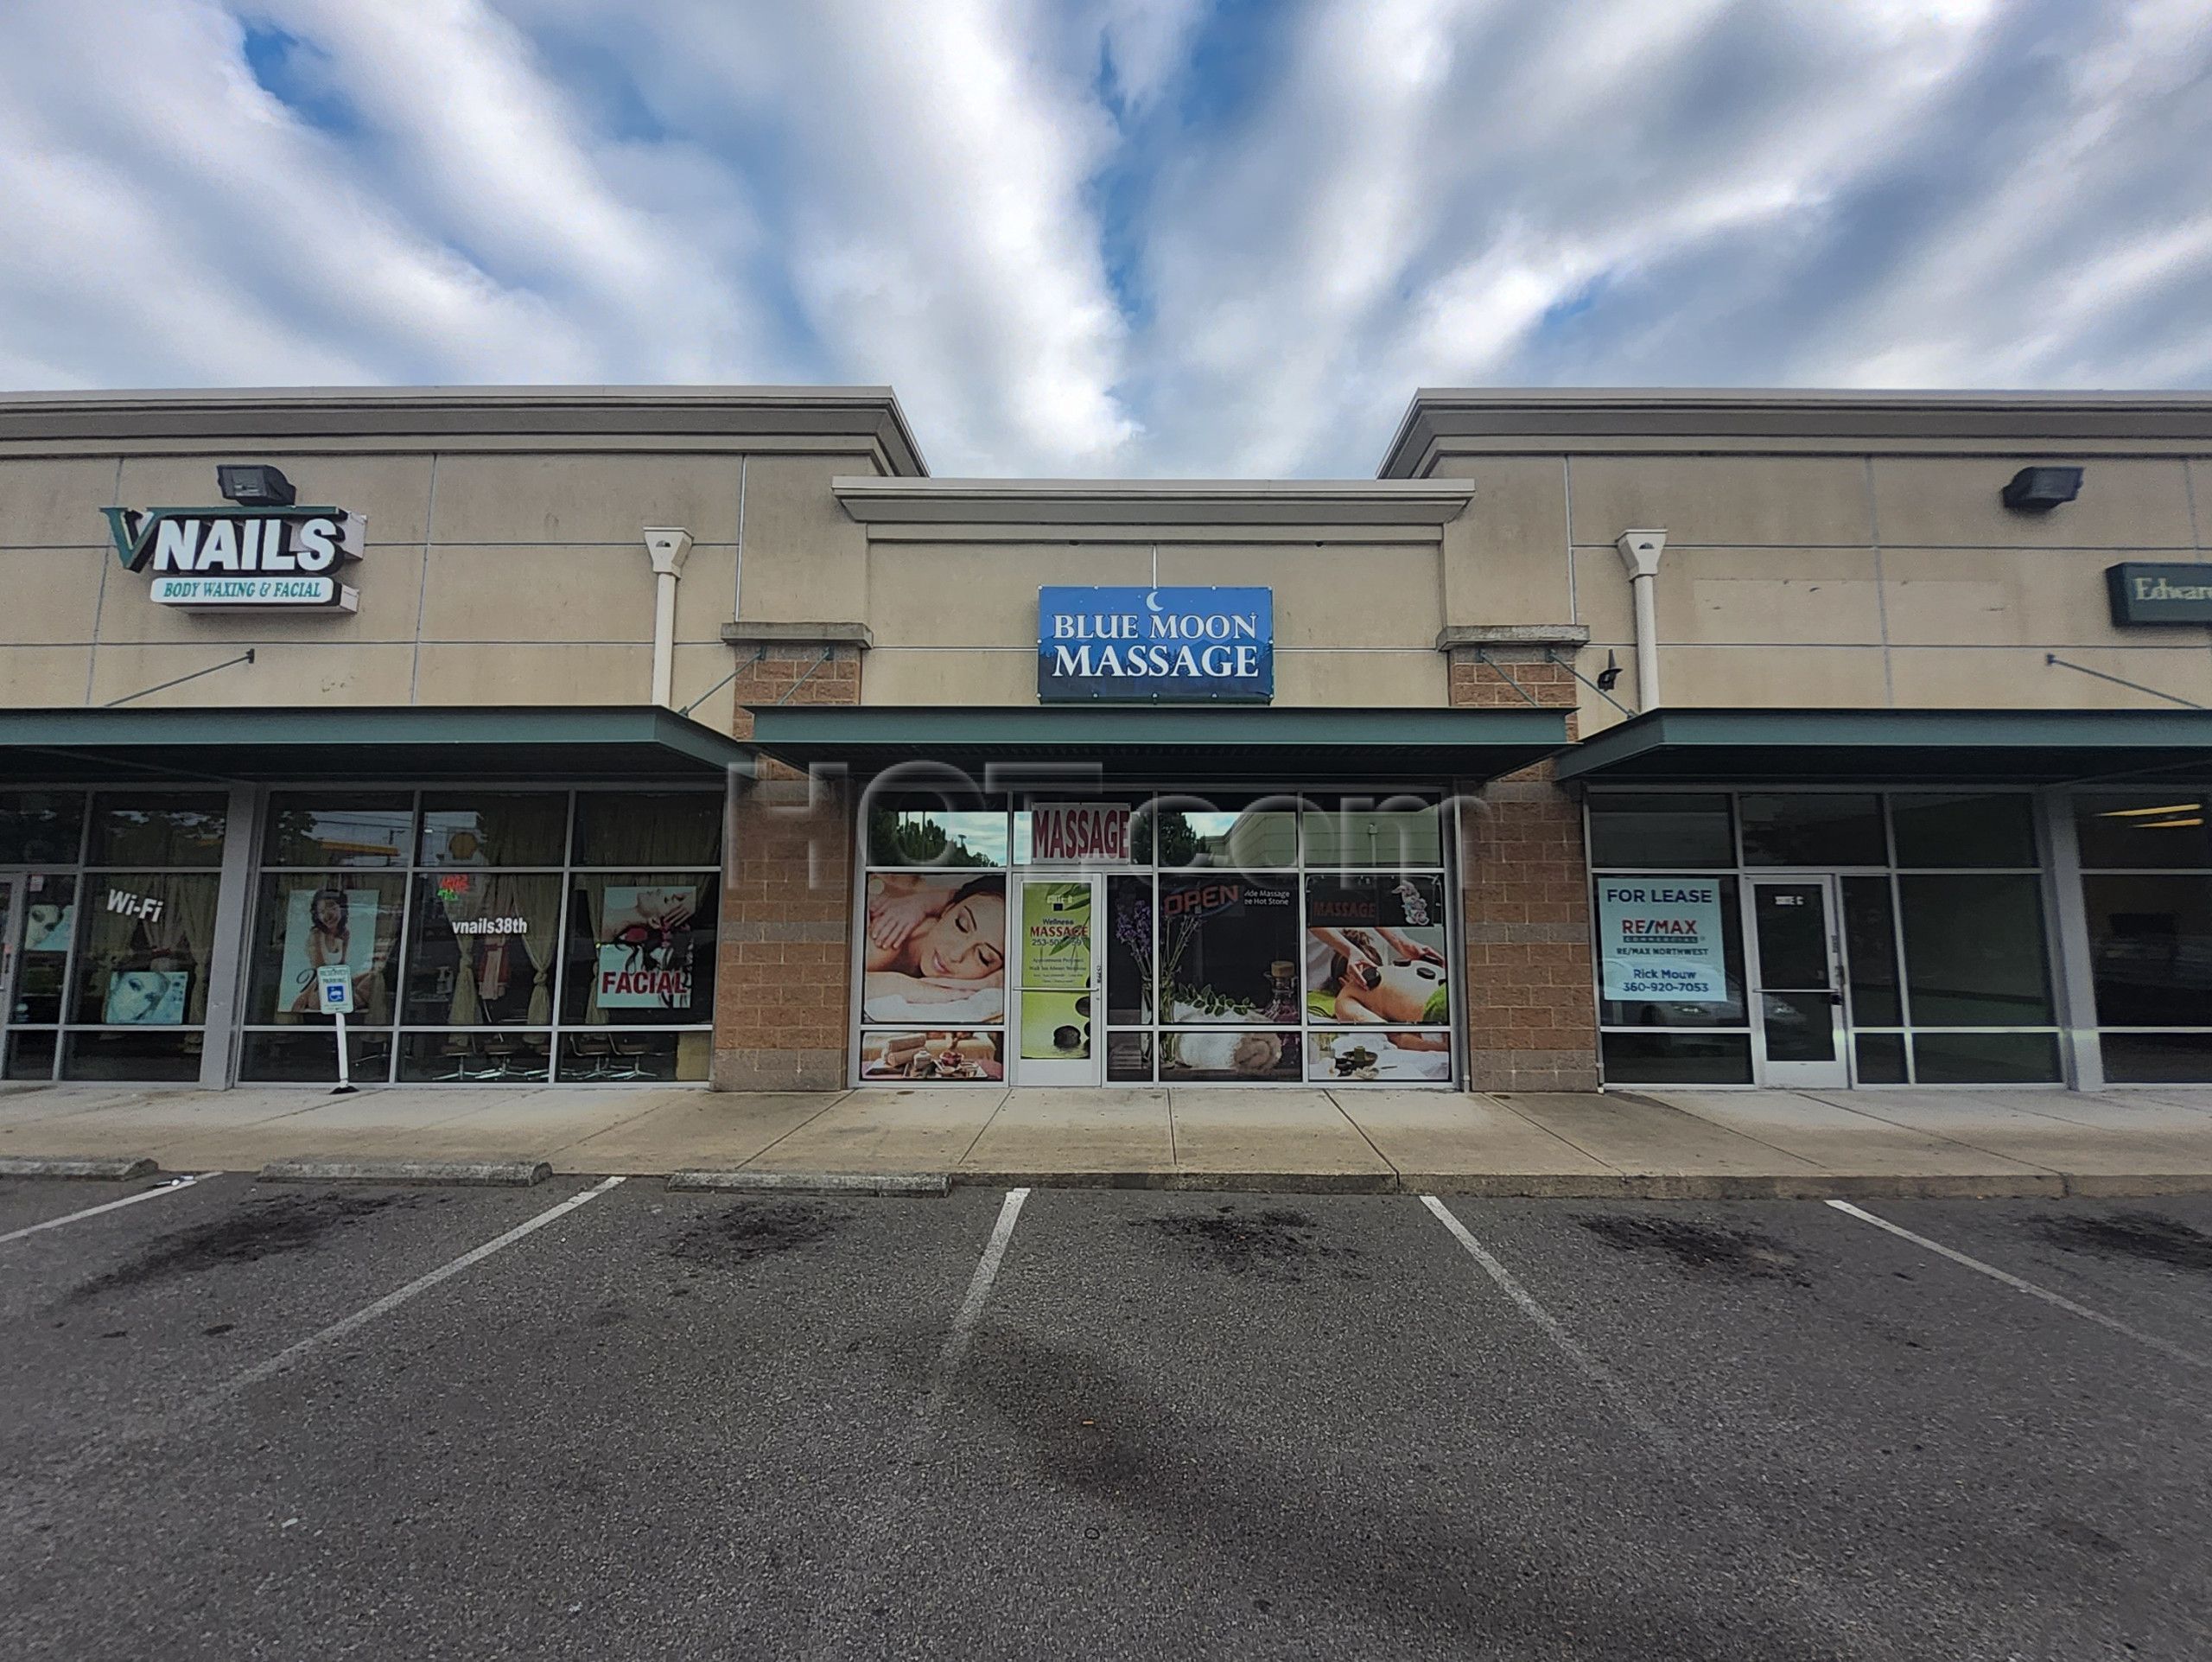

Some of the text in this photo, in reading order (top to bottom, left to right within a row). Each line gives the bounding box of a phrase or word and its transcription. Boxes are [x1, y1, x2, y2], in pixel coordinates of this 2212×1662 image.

[152, 518, 337, 571] NAILS
[163, 582, 321, 598] BODY WAXING & FACIAL
[1052, 614, 1257, 640] BLUE MOON
[1052, 644, 1259, 678] MASSAGE
[1033, 809, 1131, 858] MASSAGE
[1163, 884, 1239, 916] OPEN
[1260, 889, 1290, 899] Massage
[1607, 889, 1713, 903] FOR LEASE
[106, 888, 163, 923] Wi-Fi
[1313, 901, 1376, 917] MASSAGE
[451, 917, 528, 934] vnails38th
[1030, 926, 1089, 938] MASSAGE
[1622, 919, 1698, 934] RE/MAX
[1653, 947, 1709, 956] NORTHWEST
[1633, 969, 1697, 979] Rick Mouw
[602, 971, 688, 994] FACIAL
[1623, 982, 1709, 992] 360-920-7053
